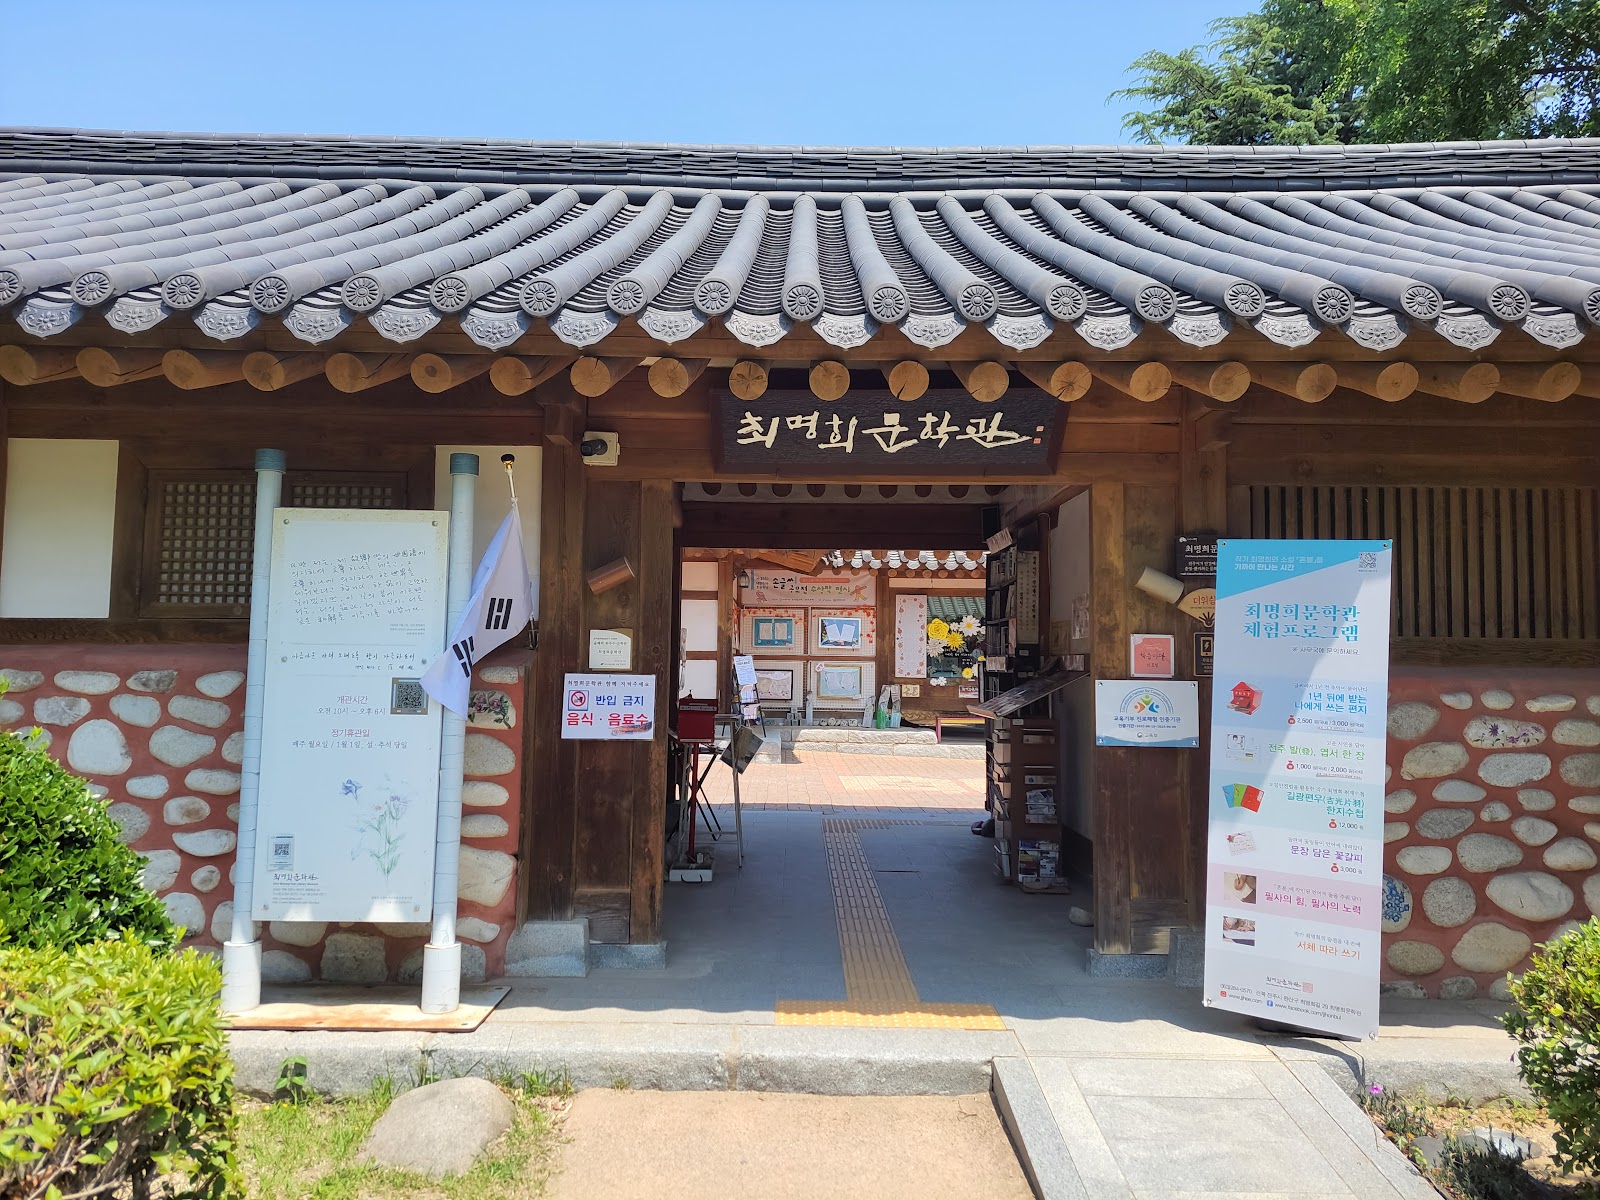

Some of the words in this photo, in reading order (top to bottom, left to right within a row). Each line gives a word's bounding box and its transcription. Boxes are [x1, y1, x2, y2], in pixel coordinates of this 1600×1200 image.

[737, 411, 1032, 453] 최명희문학관
[773, 578, 794, 589] 손글씨
[1244, 603, 1360, 622] 최명희문학관
[1243, 621, 1359, 642] 체험프로그램
[336, 695, 368, 705] 개관시간
[596, 695, 617, 706] 반입
[623, 695, 644, 706] 금지
[1309, 692, 1322, 701] 1년
[1326, 693, 1344, 702] 뒤에
[1348, 695, 1367, 704] 받는
[318, 707, 331, 715] 오전
[333, 707, 349, 715] 10시
[358, 708, 372, 716] 오후
[375, 708, 386, 716] 6시
[1295, 701, 1322, 711] 나에게
[1326, 704, 1344, 712] 쓰는
[1348, 705, 1367, 714] 편지
[567, 712, 593, 726] 음식
[608, 713, 648, 726] 음료수
[331, 729, 370, 738] 정기휴관일
[394, 741, 407, 749] 당일
[1268, 744, 1285, 753] 전주
[1320, 748, 1338, 758] 엽서
[1342, 750, 1351, 759] 한
[1356, 751, 1365, 760] 장
[1327, 806, 1364, 818] 한지수첩
[1291, 846, 1309, 856] 문장
[1313, 849, 1330, 858] 담은
[1335, 851, 1362, 863] 꽃갈피
[1265, 892, 1292, 904] 필사의
[1296, 896, 1308, 907] 힘,
[1311, 898, 1338, 911] 필사의
[1342, 904, 1361, 915] 노력
[1298, 941, 1316, 952] 서체
[1320, 944, 1338, 956] 따라
[1342, 949, 1360, 960] 쓰기
